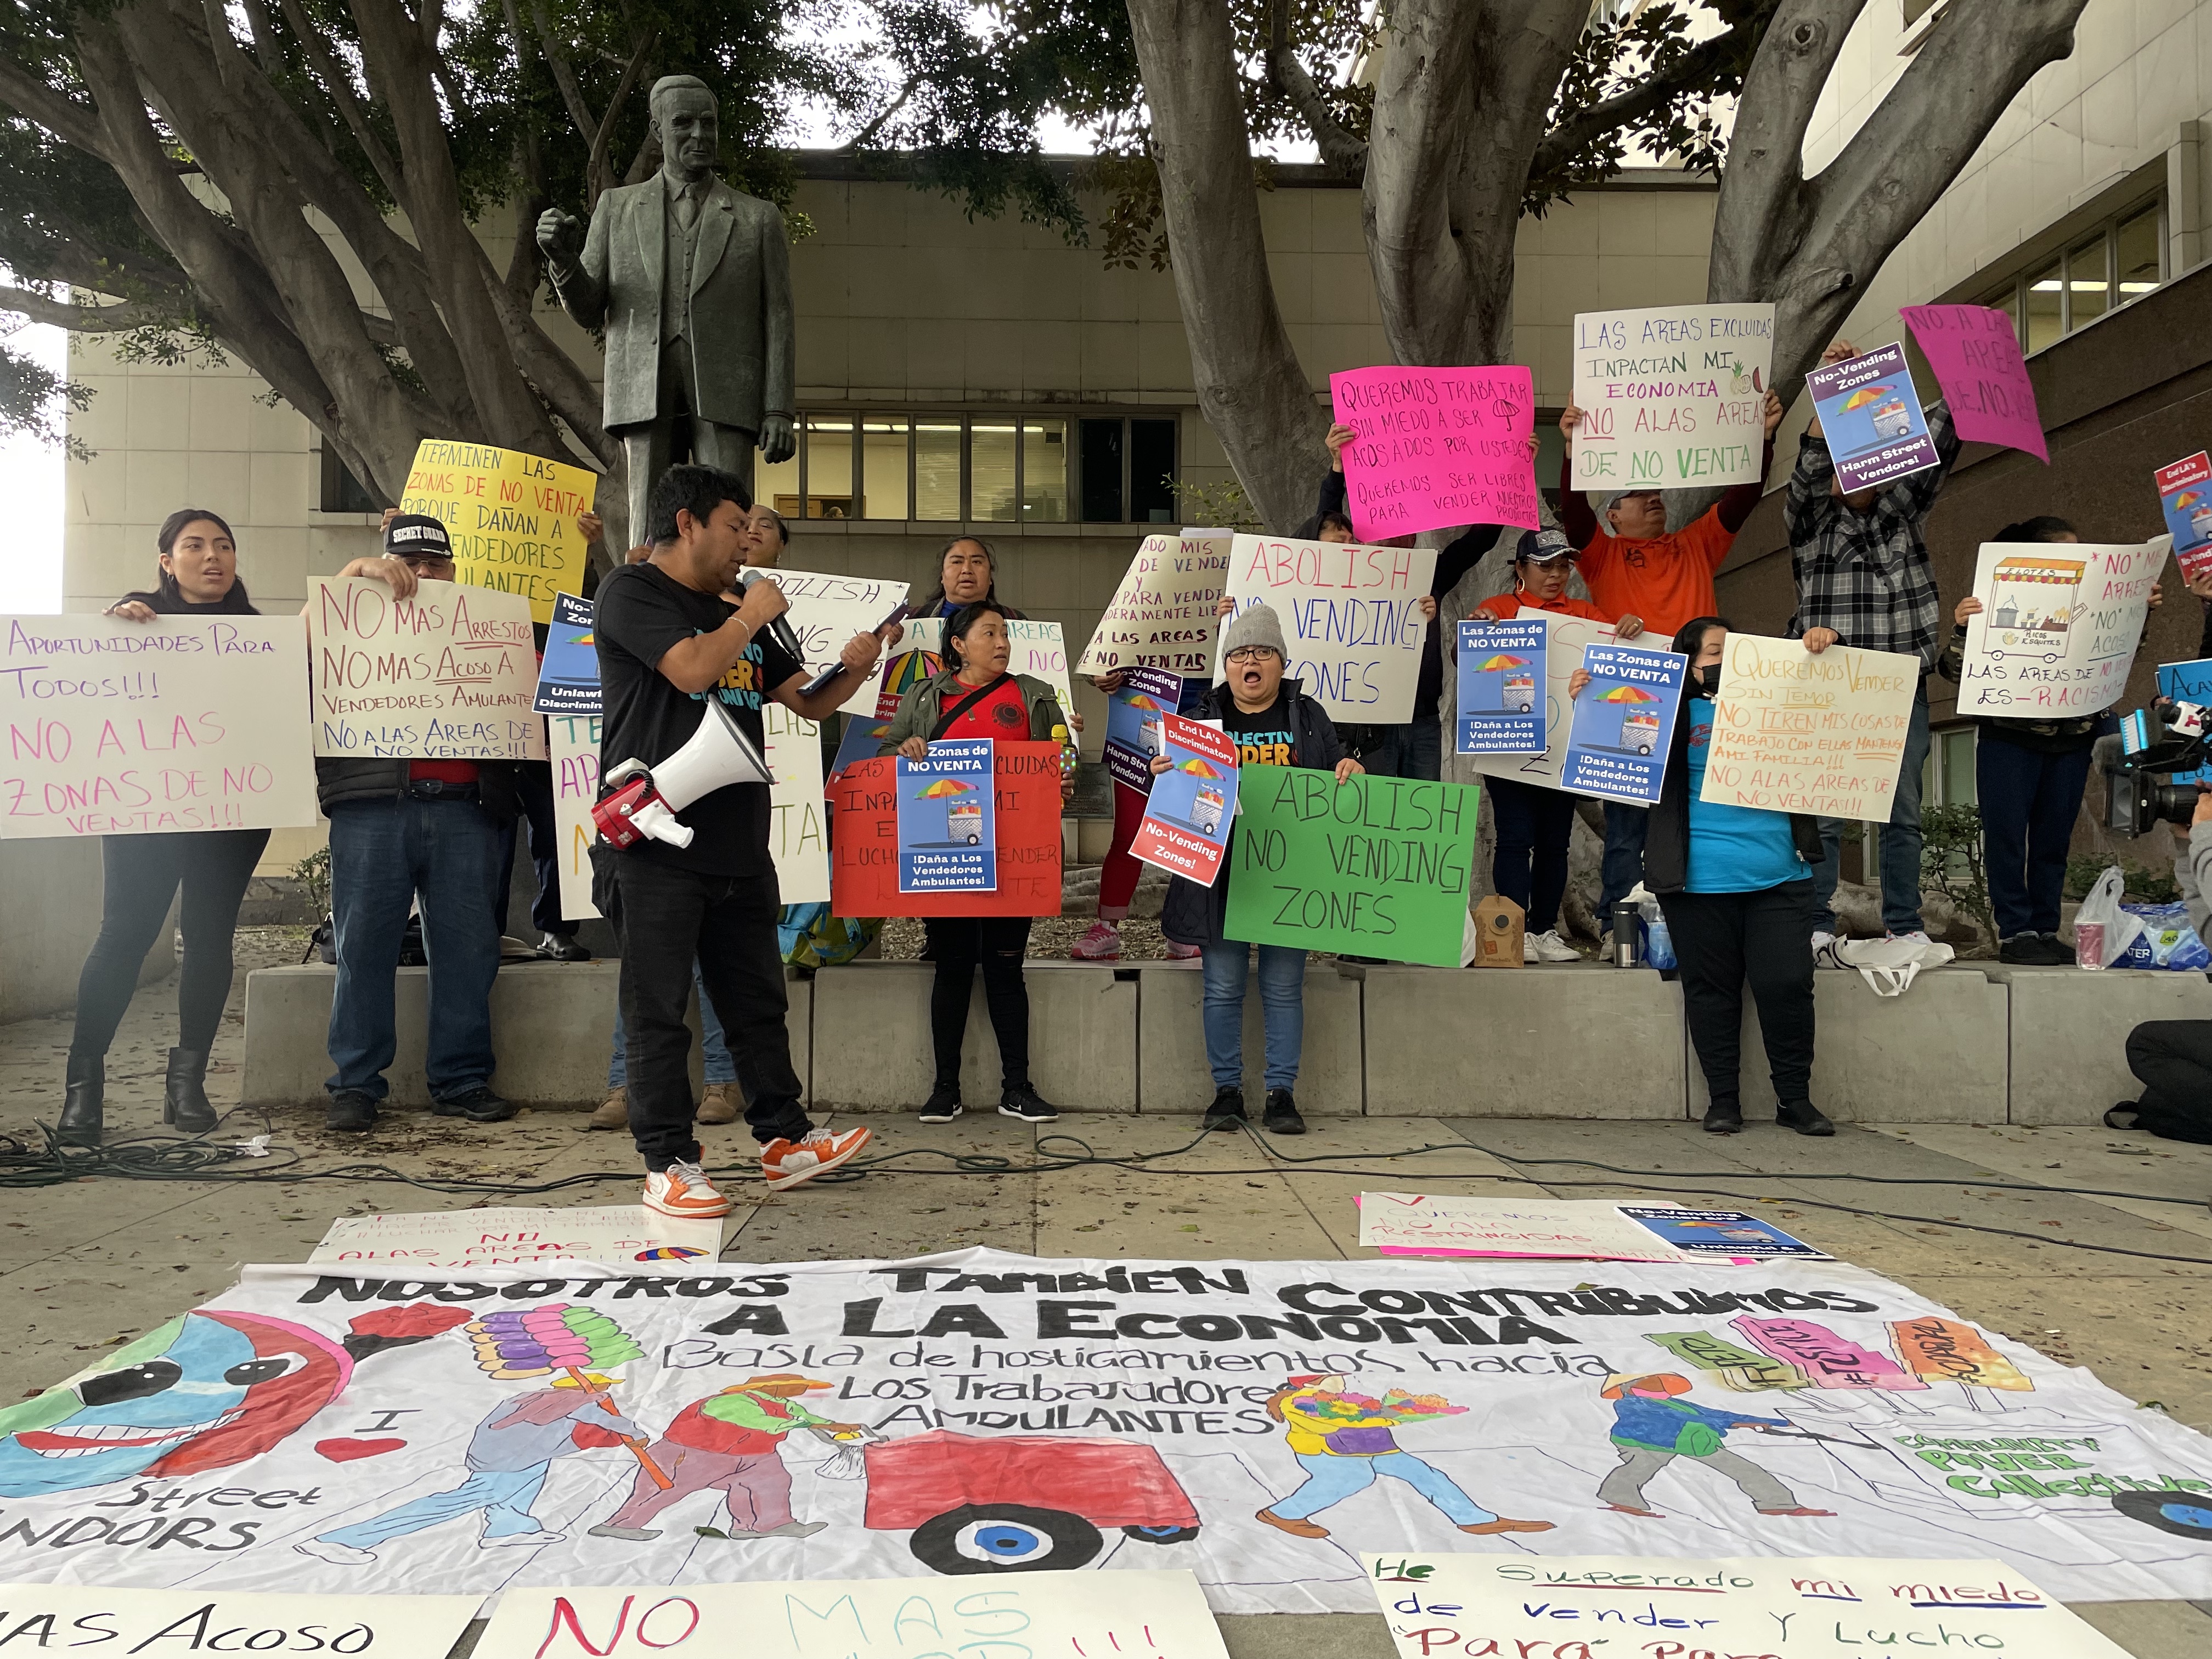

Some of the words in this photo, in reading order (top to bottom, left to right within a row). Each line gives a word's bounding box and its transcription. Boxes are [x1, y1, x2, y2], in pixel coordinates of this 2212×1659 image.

[1579, 321, 1627, 350] LAS
[1642, 318, 1703, 345] AREAS
[1711, 318, 1773, 341] EXCLUIDAS
[1587, 352, 1686, 378] INPACTAN
[1705, 351, 1734, 369] MI
[1814, 349, 1898, 386] No-Vending
[1606, 381, 1719, 399] ECONOMIA
[1836, 368, 1881, 391] Zones
[1341, 379, 1438, 413] QUEREMOS
[1442, 380, 1527, 403] TRABAJAR
[1355, 419, 1374, 439] SIN
[1383, 410, 1429, 432] MIEDO
[1437, 411, 1449, 429] A
[1454, 409, 1482, 428] SER
[1584, 408, 1614, 435] NO
[1717, 400, 1766, 427] AREAS
[1443, 436, 1473, 455] POR
[1481, 440, 1531, 463] USTEDES
[1841, 453, 1881, 474] Harm
[1882, 438, 1927, 462] Street
[420, 443, 503, 470] TERMINEN
[523, 455, 555, 481] LAS
[1581, 450, 1618, 478] DE
[1631, 450, 1663, 479] NO
[1677, 444, 1751, 479] VENTA
[1857, 454, 1920, 482] Vendors!
[407, 472, 454, 493] ZONAS
[464, 476, 486, 496] DE
[501, 479, 523, 503] NO
[535, 487, 585, 517] VENTA
[1357, 475, 1431, 506] QUEREMOS
[1448, 472, 1477, 488] SER
[1484, 473, 1526, 492] LIBRES
[1369, 502, 1409, 524] PARA
[1434, 490, 1492, 509] VENDER
[477, 505, 539, 535] DAÑAN
[550, 520, 562, 539] A
[393, 526, 422, 543] SECRET
[1181, 540, 1212, 554] MIS
[1139, 558, 1158, 573] DE
[1246, 541, 1410, 590] ABOLISH
[2006, 568, 2056, 577] ELOTES
[1136, 576, 1142, 592] Y
[1123, 591, 1163, 605] PARA
[320, 583, 385, 639] NO
[395, 601, 443, 635] MAS
[452, 595, 531, 641] ARRESTOS
[1293, 597, 1418, 650] VENDING
[1112, 631, 1139, 644] LAS
[1149, 629, 1207, 644] AREAS
[1462, 625, 1484, 636] Las
[1486, 625, 1525, 636] Zonas
[1528, 624, 1543, 634] de
[1468, 639, 1487, 648] NO
[1489, 637, 1537, 648] VENTA
[323, 645, 371, 689] NO
[377, 652, 431, 684] MAS
[437, 646, 492, 678] ACOSO
[497, 651, 514, 675] A
[1029, 650, 1066, 672] NO
[1096, 651, 1118, 667] NO
[1136, 653, 1206, 671] VENTAS
[1589, 650, 1613, 663] Las
[1616, 652, 1655, 667] Zonas
[1661, 658, 1681, 670] de
[1733, 637, 1843, 681] QUEREMOS
[1847, 653, 1906, 693] VENDER
[1593, 663, 1616, 676] NO
[1618, 666, 1671, 685] VENTA
[1967, 663, 2007, 679] LAS
[2019, 667, 2070, 682] AREAS
[2074, 667, 2095, 680] DE
[1129, 679, 1161, 695] Zones
[1726, 679, 1774, 701] SIN
[1780, 687, 1837, 706] TEMOR
[322, 694, 443, 715] VENDEDORES
[1515, 720, 1533, 729] Los
[1719, 702, 1751, 729] NO
[1756, 708, 1819, 731] TIREN
[1822, 712, 1848, 730] MIS
[1894, 715, 1908, 728] DE
[10, 718, 71, 763] NO
[324, 720, 357, 749] NO
[424, 718, 499, 745] AREAS
[508, 720, 533, 741] DE
[1179, 720, 1198, 733] End
[1199, 727, 1221, 745] LA's
[1469, 730, 1534, 740] Vendedores
[1716, 728, 1785, 747] TRABAJO
[1788, 737, 1813, 751] CON
[1818, 740, 1852, 751] ELLAS
[375, 745, 413, 758] NO
[927, 747, 969, 757] Zonas
[972, 746, 988, 756] de
[1168, 730, 1233, 764] Discriminatory
[1468, 740, 1536, 750] Ambulantes!
[908, 761, 929, 772] NO
[933, 760, 983, 771] VENTA
[1110, 761, 1146, 786] Vendors!
[1577, 765, 1649, 786] Vendedores
[1630, 763, 1650, 774] Los
[4, 771, 152, 816] ZONAS
[159, 770, 208, 801] DE
[224, 763, 273, 795] NO
[1573, 776, 1650, 796] Ambulantes!
[1712, 764, 1742, 787] NO
[1812, 774, 1868, 792] AREAS
[1874, 777, 1891, 793] DE
[1272, 771, 1464, 835] ABOLISH
[1737, 790, 1771, 805] NO
[1146, 823, 1218, 861] No-Vending
[914, 855, 949, 864] !Daña
[962, 854, 981, 862] Los
[1154, 845, 1197, 871] Zones!
[1245, 829, 1286, 872] NO
[1327, 833, 1464, 894] VENDING
[911, 877, 985, 887] Ambulantes!
[913, 866, 983, 875] Vendedores
[1272, 885, 1396, 934] ZONES
[1387, 1208, 1570, 1222] QUEREMOS
[1628, 1207, 1741, 1220] No-Vending
[466, 1242, 592, 1254] AREAS
[613, 1240, 659, 1249] DE
[480, 1233, 540, 1244] NO
[1691, 1244, 1771, 1254] Unlawful
[297, 1273, 792, 1304] NOSOTROS
[701, 1304, 791, 1335] A
[839, 1297, 1008, 1339] LA
[1037, 1299, 1583, 1344] ECONOMIA
[890, 1342, 956, 1368] de
[1429, 1351, 1621, 1375] hacia
[1893, 1434, 2101, 1452] COMMUNITY
[1915, 1449, 2096, 1471] POWER
[1375, 1558, 1436, 1579] He
[1394, 1592, 1464, 1617] de
[1523, 1602, 1719, 1629] vender
[534, 1593, 699, 1659] NO
[785, 1591, 1031, 1652] MAS
